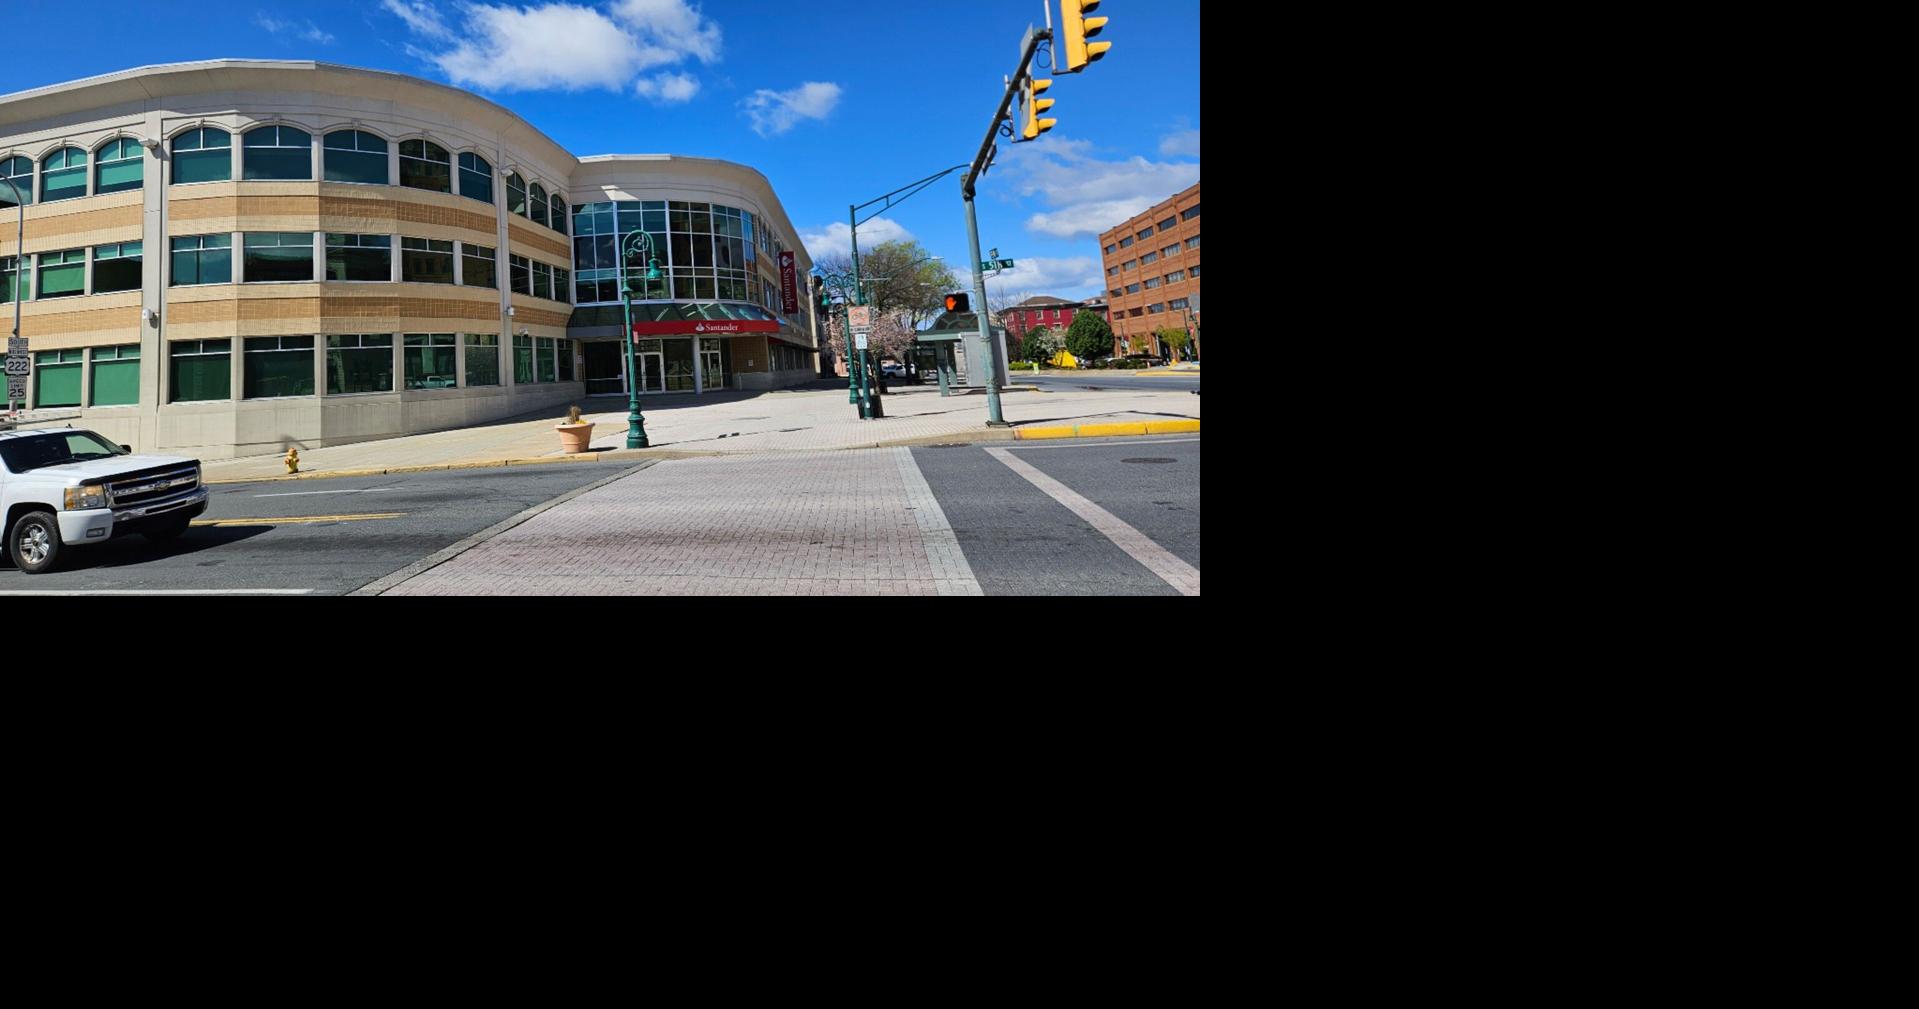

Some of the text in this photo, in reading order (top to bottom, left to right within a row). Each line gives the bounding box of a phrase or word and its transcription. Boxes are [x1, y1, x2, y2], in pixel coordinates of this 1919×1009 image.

[783, 268, 794, 311] Santander
[705, 323, 738, 331] Santander
[8, 361, 28, 371] 222
[9, 388, 25, 397] 25
